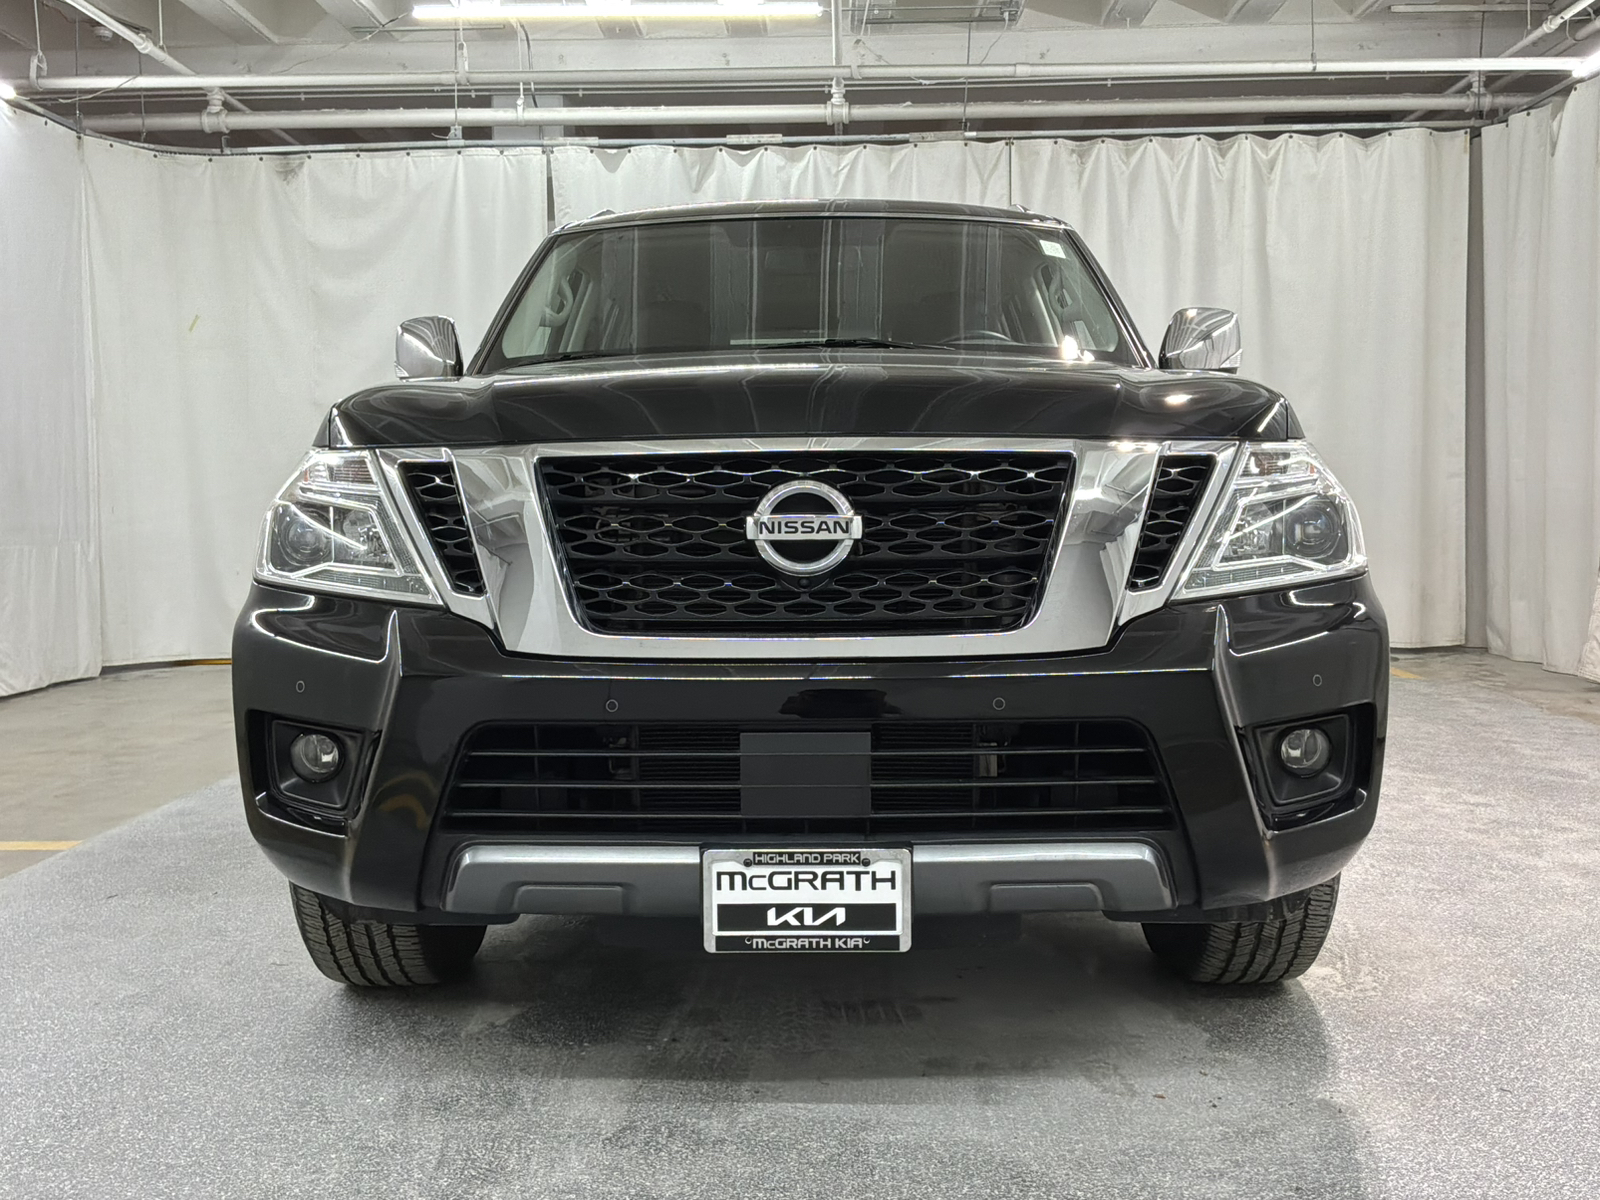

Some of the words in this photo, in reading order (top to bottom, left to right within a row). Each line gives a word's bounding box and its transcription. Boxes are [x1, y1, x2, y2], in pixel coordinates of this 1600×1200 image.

[759, 520, 850, 534] NISSAN
[754, 853, 820, 864] HIGHLAND
[823, 853, 860, 864] PARK
[767, 907, 846, 926] KIA
[835, 938, 863, 949] KIA
